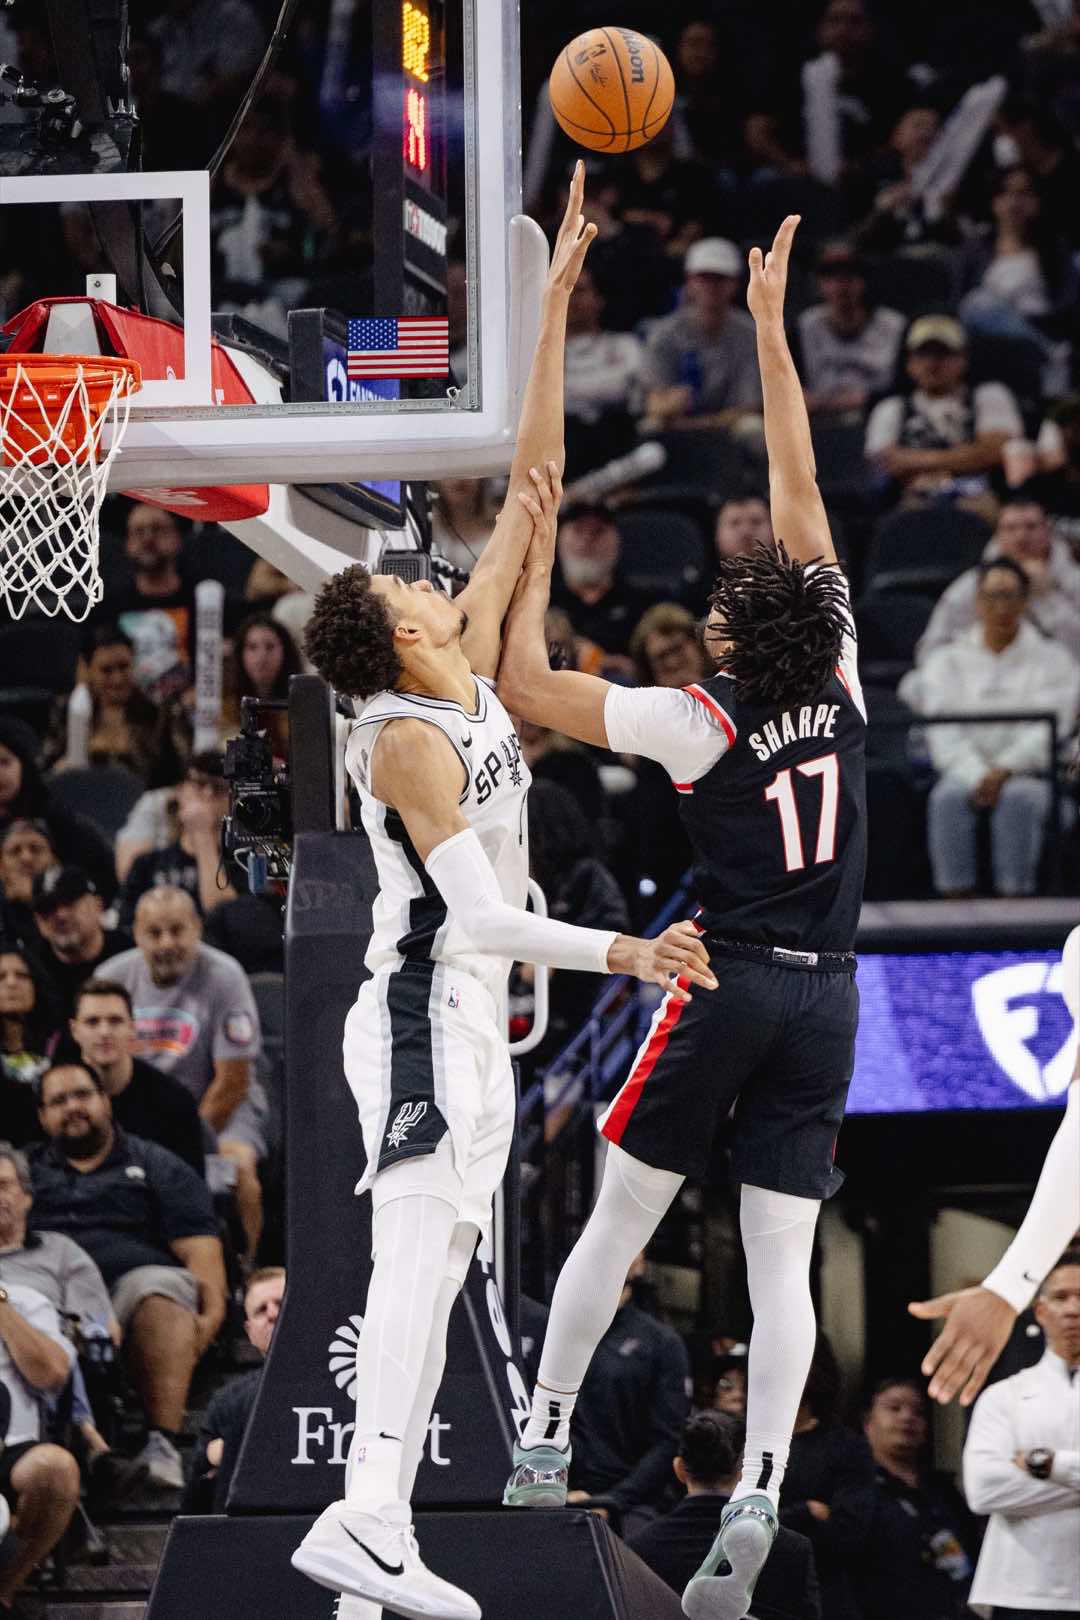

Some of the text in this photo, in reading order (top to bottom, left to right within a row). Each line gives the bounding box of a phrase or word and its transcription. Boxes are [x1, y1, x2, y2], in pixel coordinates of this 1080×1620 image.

[748, 703, 841, 762] SHARPE
[764, 751, 840, 873] 17
[290, 1406, 451, 1466] Frt
